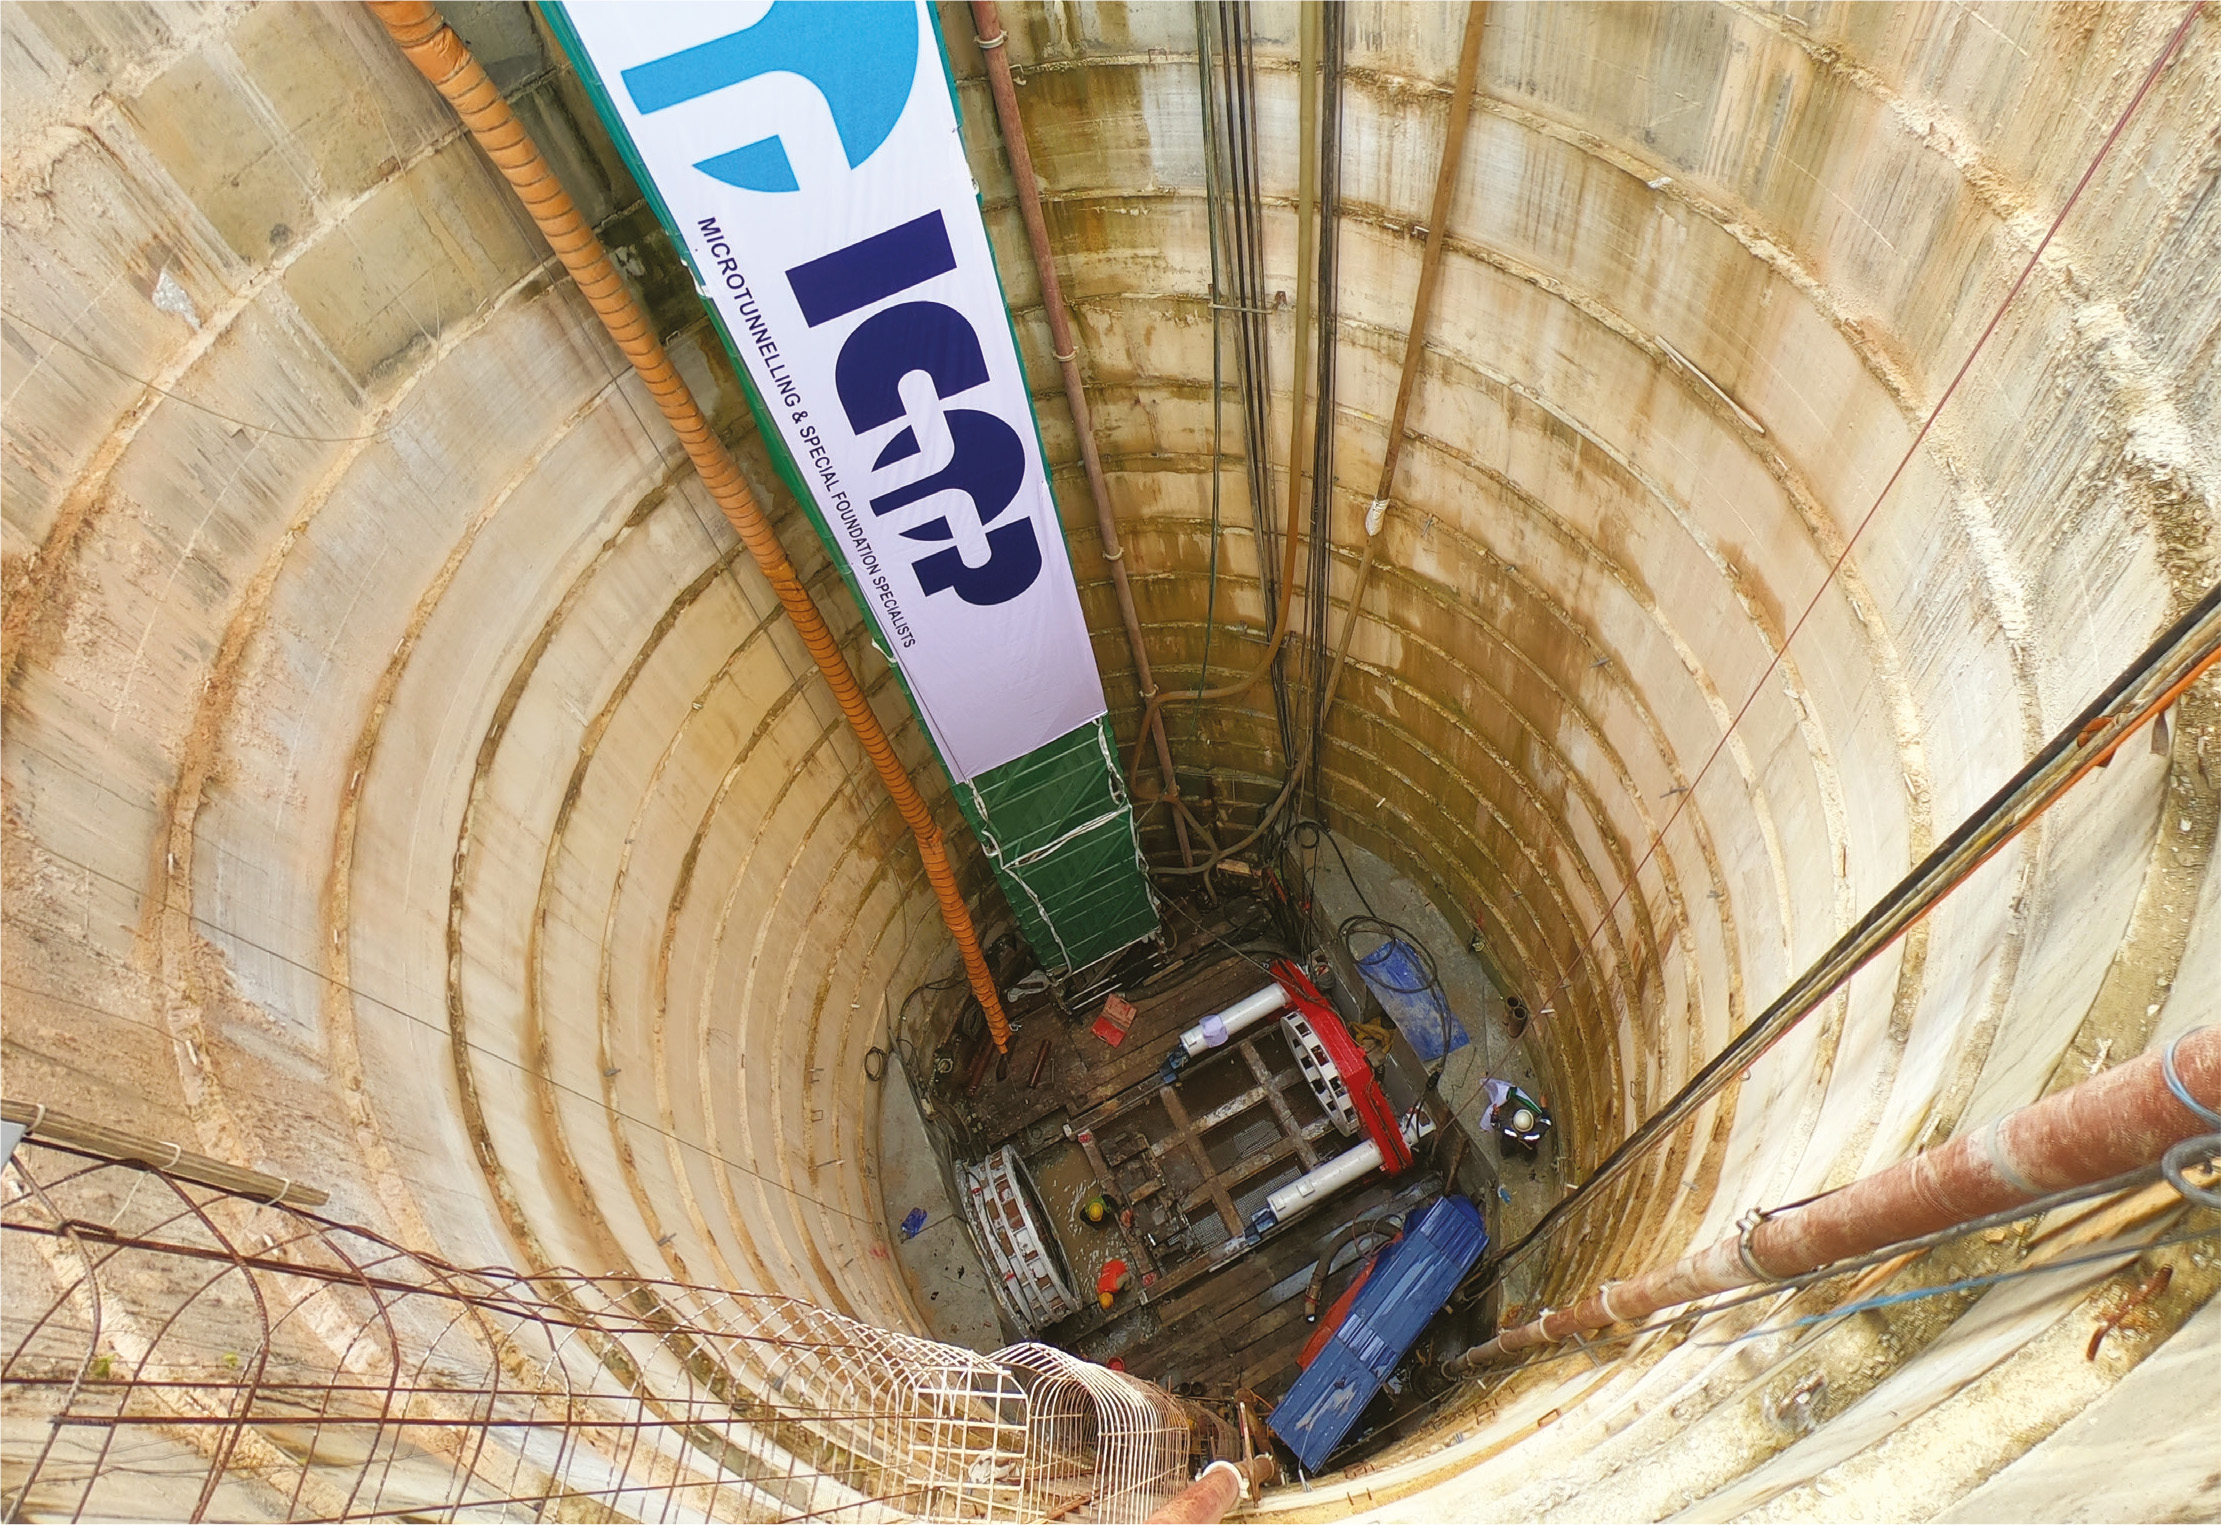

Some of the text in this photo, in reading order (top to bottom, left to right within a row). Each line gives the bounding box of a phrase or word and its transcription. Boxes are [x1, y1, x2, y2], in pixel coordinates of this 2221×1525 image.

[697, 216, 916, 649] MICROTUNNELLING & SPECIAL FOUNDATION SPECIALISTS
